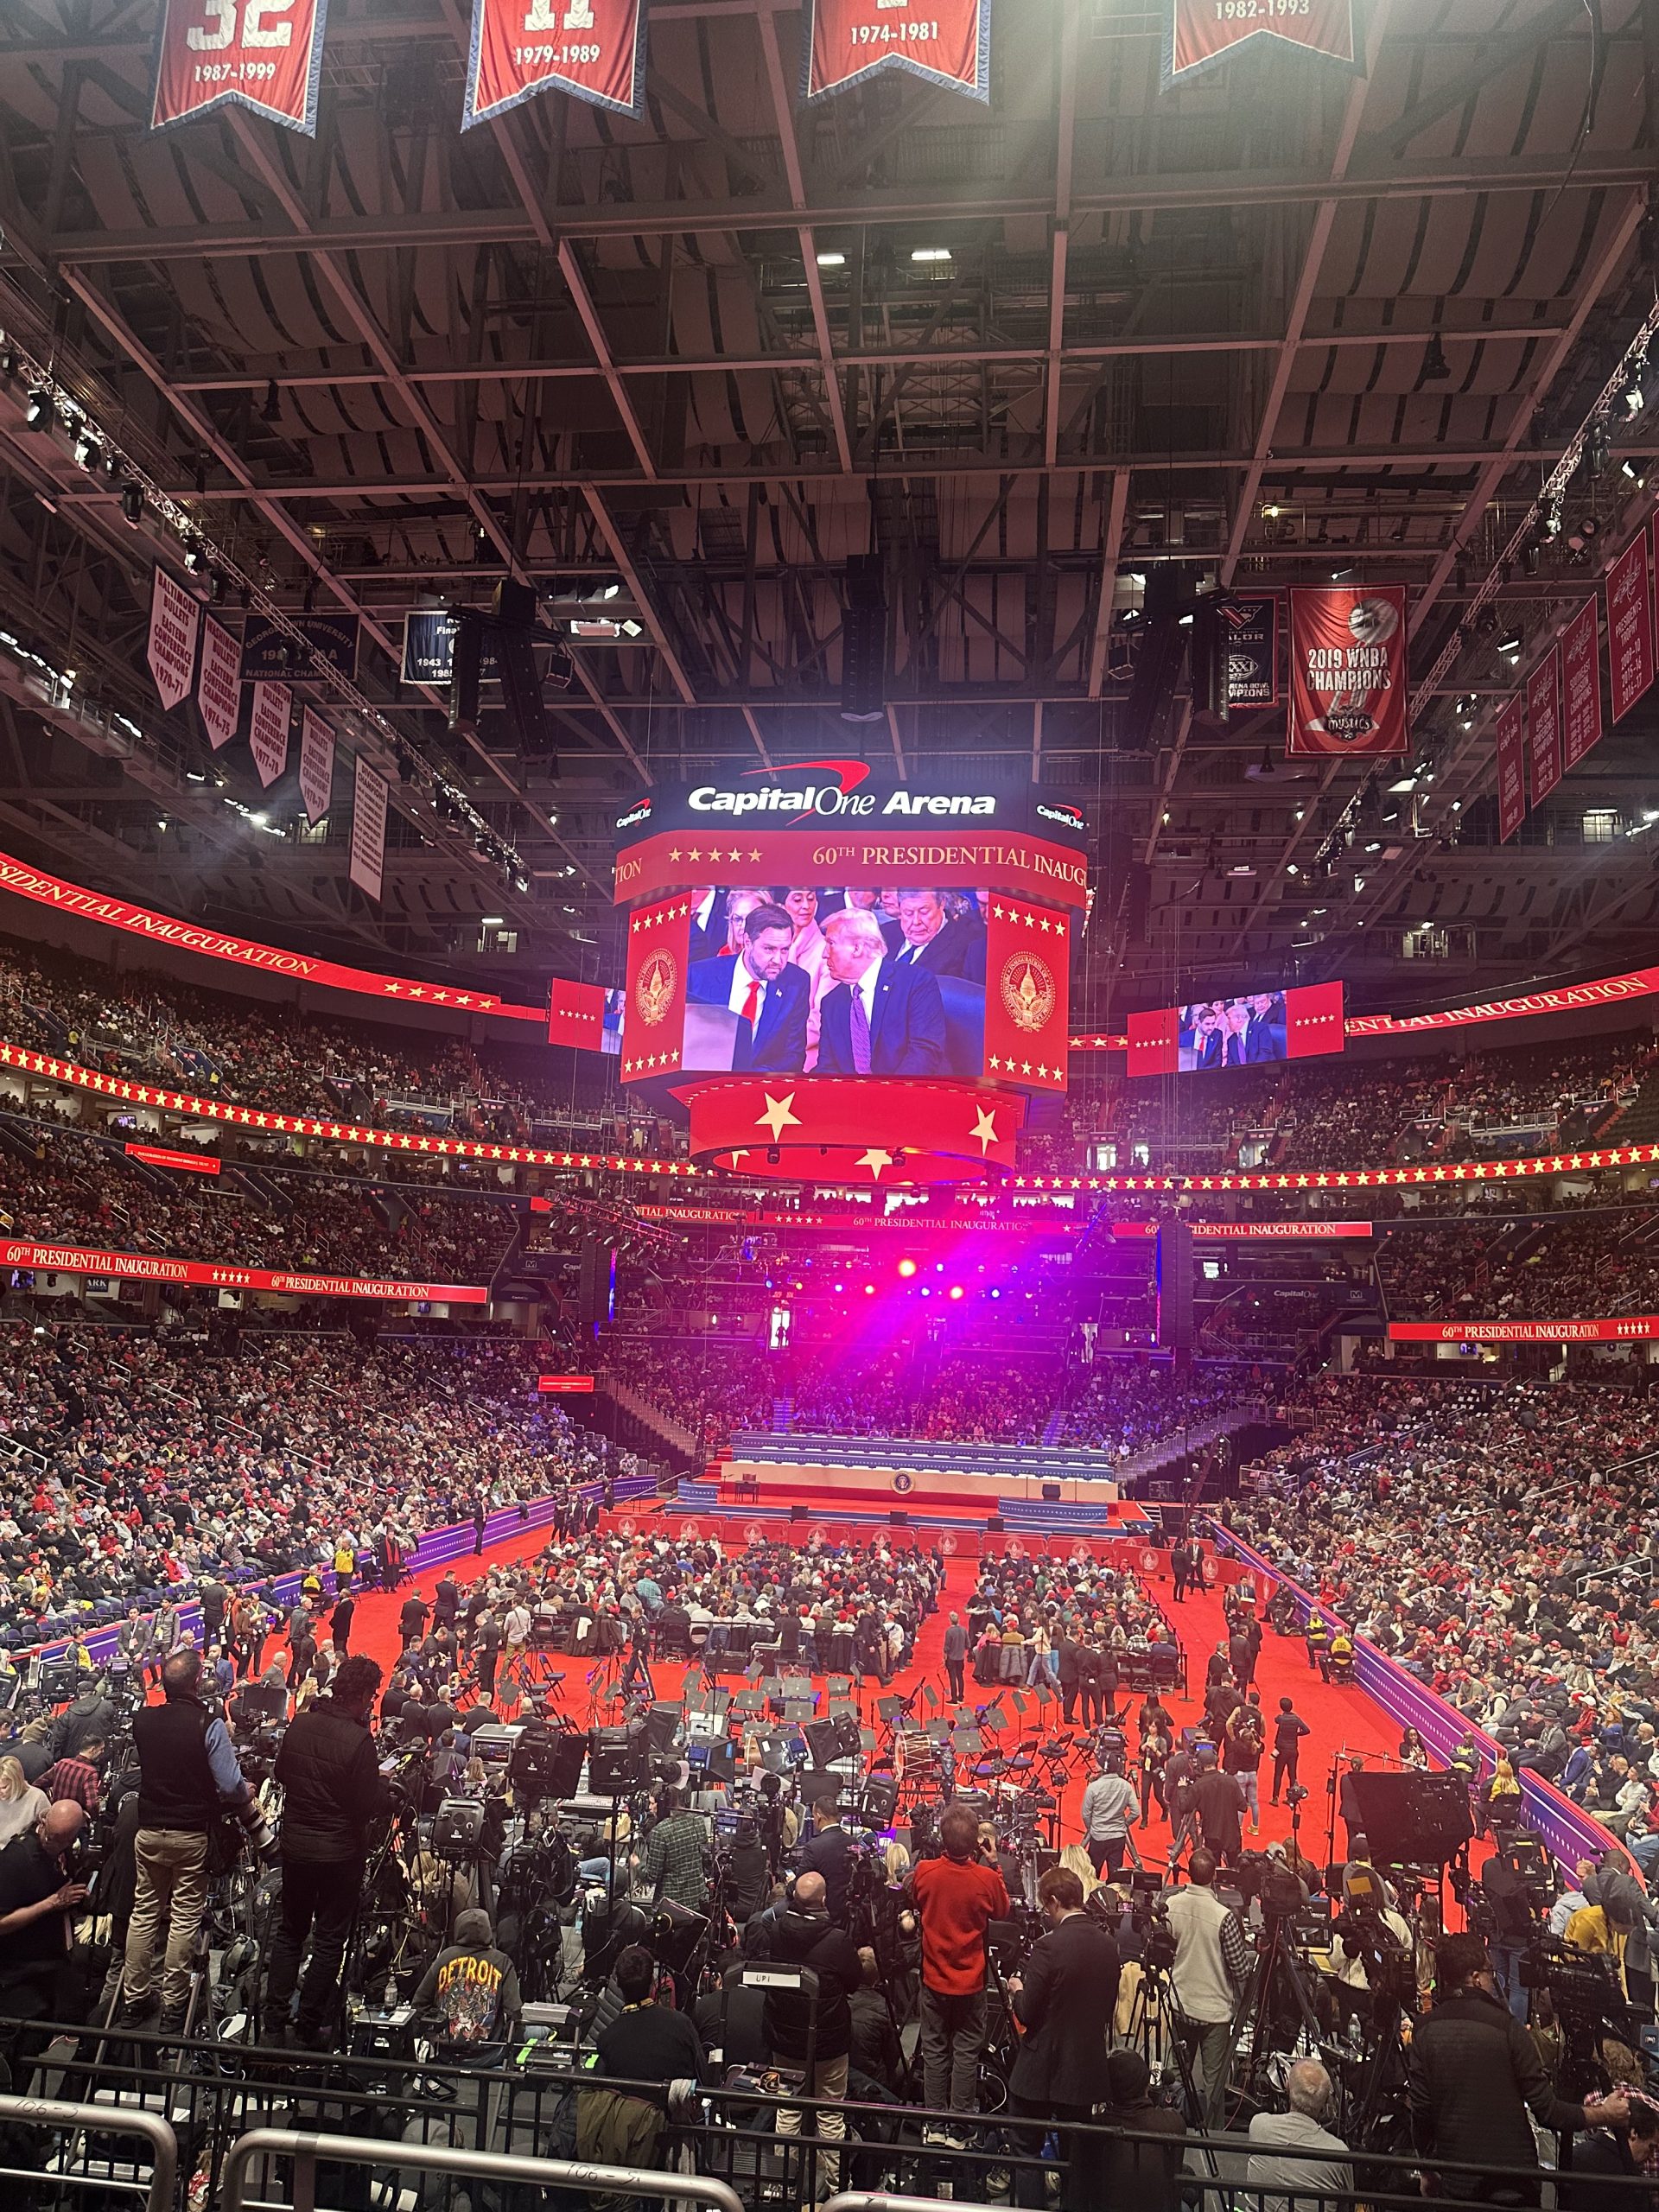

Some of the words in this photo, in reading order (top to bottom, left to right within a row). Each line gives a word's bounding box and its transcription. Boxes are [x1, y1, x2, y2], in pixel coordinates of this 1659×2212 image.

[1216, 0, 1310, 20] 1982-1993
[851, 22, 938, 45] 1974-1981
[516, 45, 601, 65] 1979-1989
[195, 62, 276, 82] 1987-1999
[157, 572, 196, 618] BALTIMORE
[163, 594, 189, 627] BULLETS
[154, 624, 192, 665] CONFERENCE
[162, 613, 187, 646] EASTERN
[207, 617, 240, 658] WASHINGTO
[245, 620, 305, 649] GEORGWN
[307, 620, 354, 649] UNIVERSITY
[154, 639, 188, 678] CHAMPIONS
[213, 639, 236, 670] BULLETS
[1308, 648, 1342, 669] 2019
[1347, 647, 1389, 668] WNBA
[156, 662, 183, 697] 1970-71
[204, 668, 238, 706] CONFERENCE
[211, 658, 233, 689] EASTERN
[246, 669, 291, 677] NATIONAL
[1306, 670, 1392, 691] CHAMPIONS
[203, 683, 235, 718] CHAMPIONS
[263, 685, 283, 712] BULLETS
[204, 704, 231, 736] 1974-75
[255, 713, 286, 747] CONFERENCE
[261, 703, 282, 729] EASTERN
[305, 709, 334, 744] WASHINGTON
[254, 727, 283, 758] CHAMPIONS
[309, 728, 328, 752] BULLETS
[255, 746, 279, 775] 1977-78
[308, 745, 327, 768] EASTERN
[358, 772, 386, 804] CHAMPIONS
[881, 791, 996, 815] Arena
[812, 846, 855, 865] 60TH
[861, 846, 1030, 869] PRESIDENTIAL
[0, 861, 126, 921] SIDENTIAL
[124, 913, 319, 975] INAUGURATION
[1443, 976, 1649, 1023] INAUGURATION
[665, 1208, 743, 1221] INAUGURATIO
[853, 1217, 872, 1226] 60TH
[874, 1217, 948, 1230] PRESIDENTIAL
[950, 1219, 1026, 1231] INAUGURATIO
[1249, 1224, 1337, 1235] INAUGURATION
[7, 1245, 30, 1262] 60TH
[32, 1249, 113, 1272] PRESIDENTIAL
[114, 1257, 188, 1279] INAUGURATION
[271, 1274, 285, 1287] 60TH
[285, 1276, 351, 1294] PRESIDENTIAL
[352, 1282, 429, 1298] INAUGURATION
[1442, 1326, 1462, 1338] 60TH
[1465, 1325, 1535, 1338] PRESIDENTIAL
[1535, 1323, 1599, 1338] INAUGURATION
[438, 1956, 502, 1991] DETROIT
